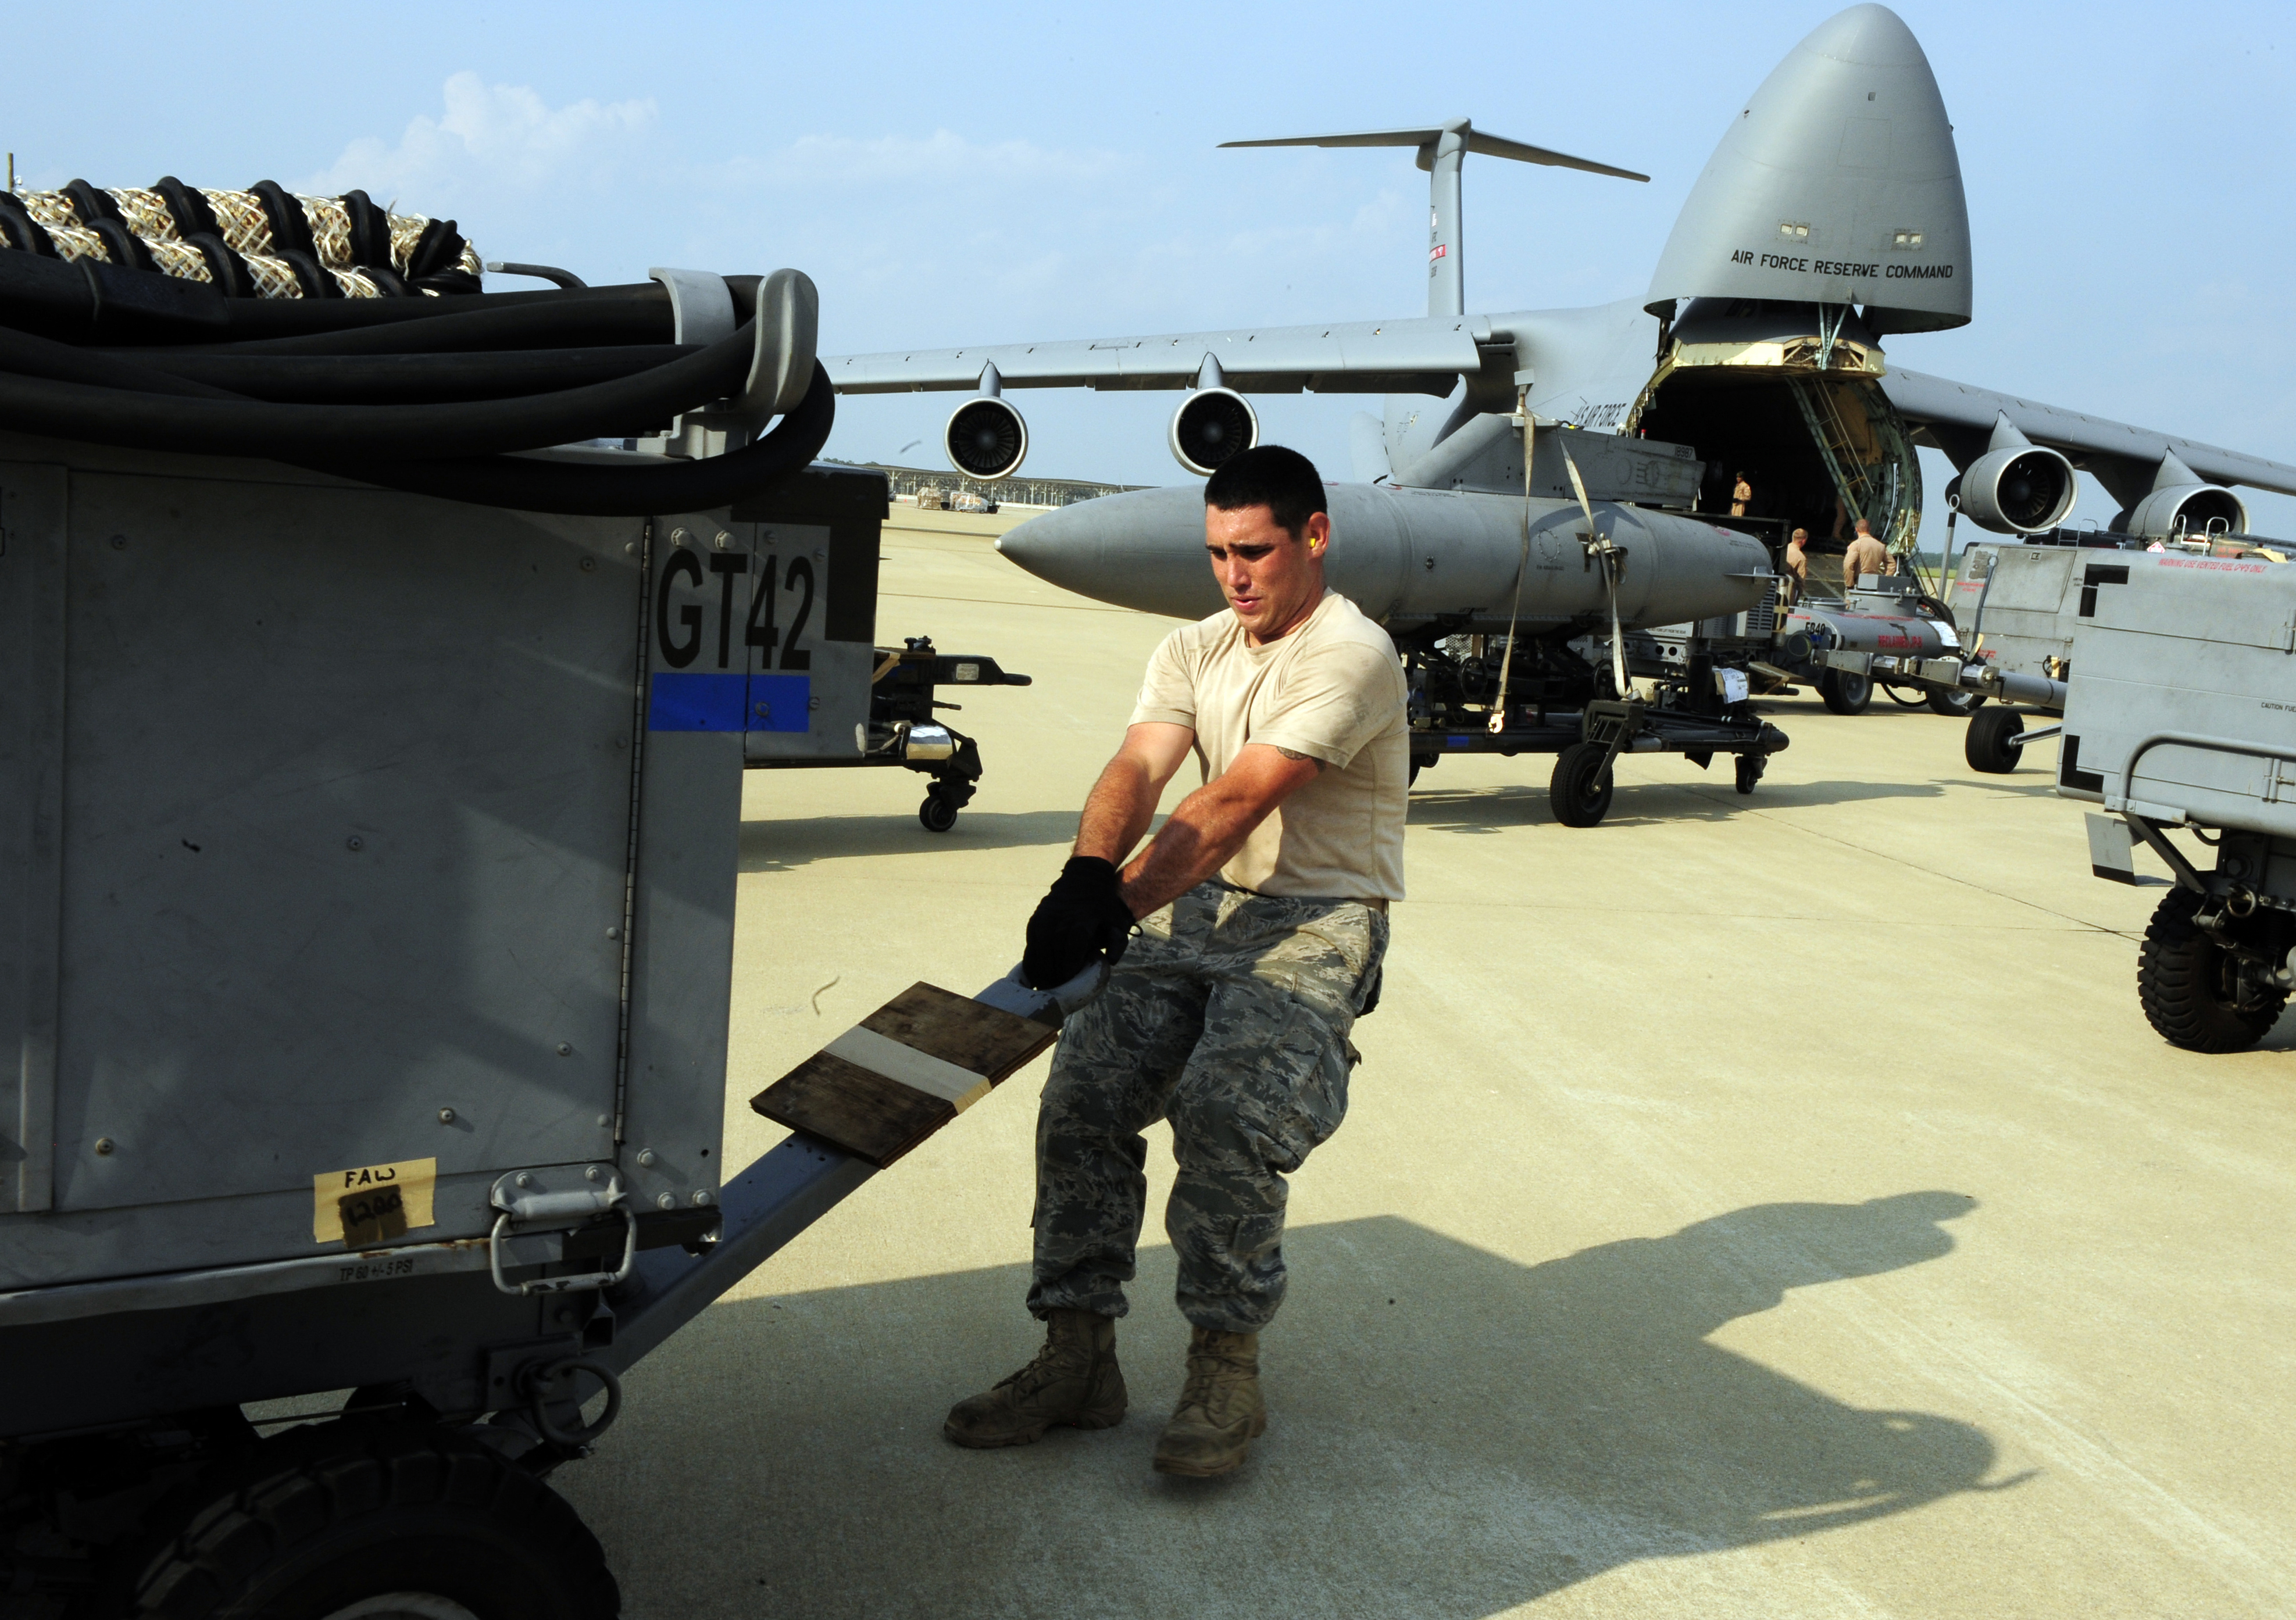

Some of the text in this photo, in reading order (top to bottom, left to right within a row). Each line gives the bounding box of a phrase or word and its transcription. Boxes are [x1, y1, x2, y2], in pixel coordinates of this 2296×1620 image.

[1730, 249, 1954, 279] AIR FORCE RESERVE COMMAND
[1582, 405, 1602, 428] AIR
[1594, 403, 1627, 428] FORCE
[2184, 560, 2198, 568] USE
[2219, 562, 2234, 571] FUEL
[657, 549, 814, 671] GT42
[2261, 702, 2283, 710] CAUTION
[344, 1168, 396, 1189] FAW
[340, 1267, 353, 1281] TP
[356, 1265, 369, 1279] 60
[387, 1262, 393, 1275] 5
[395, 1259, 413, 1274] PSI
